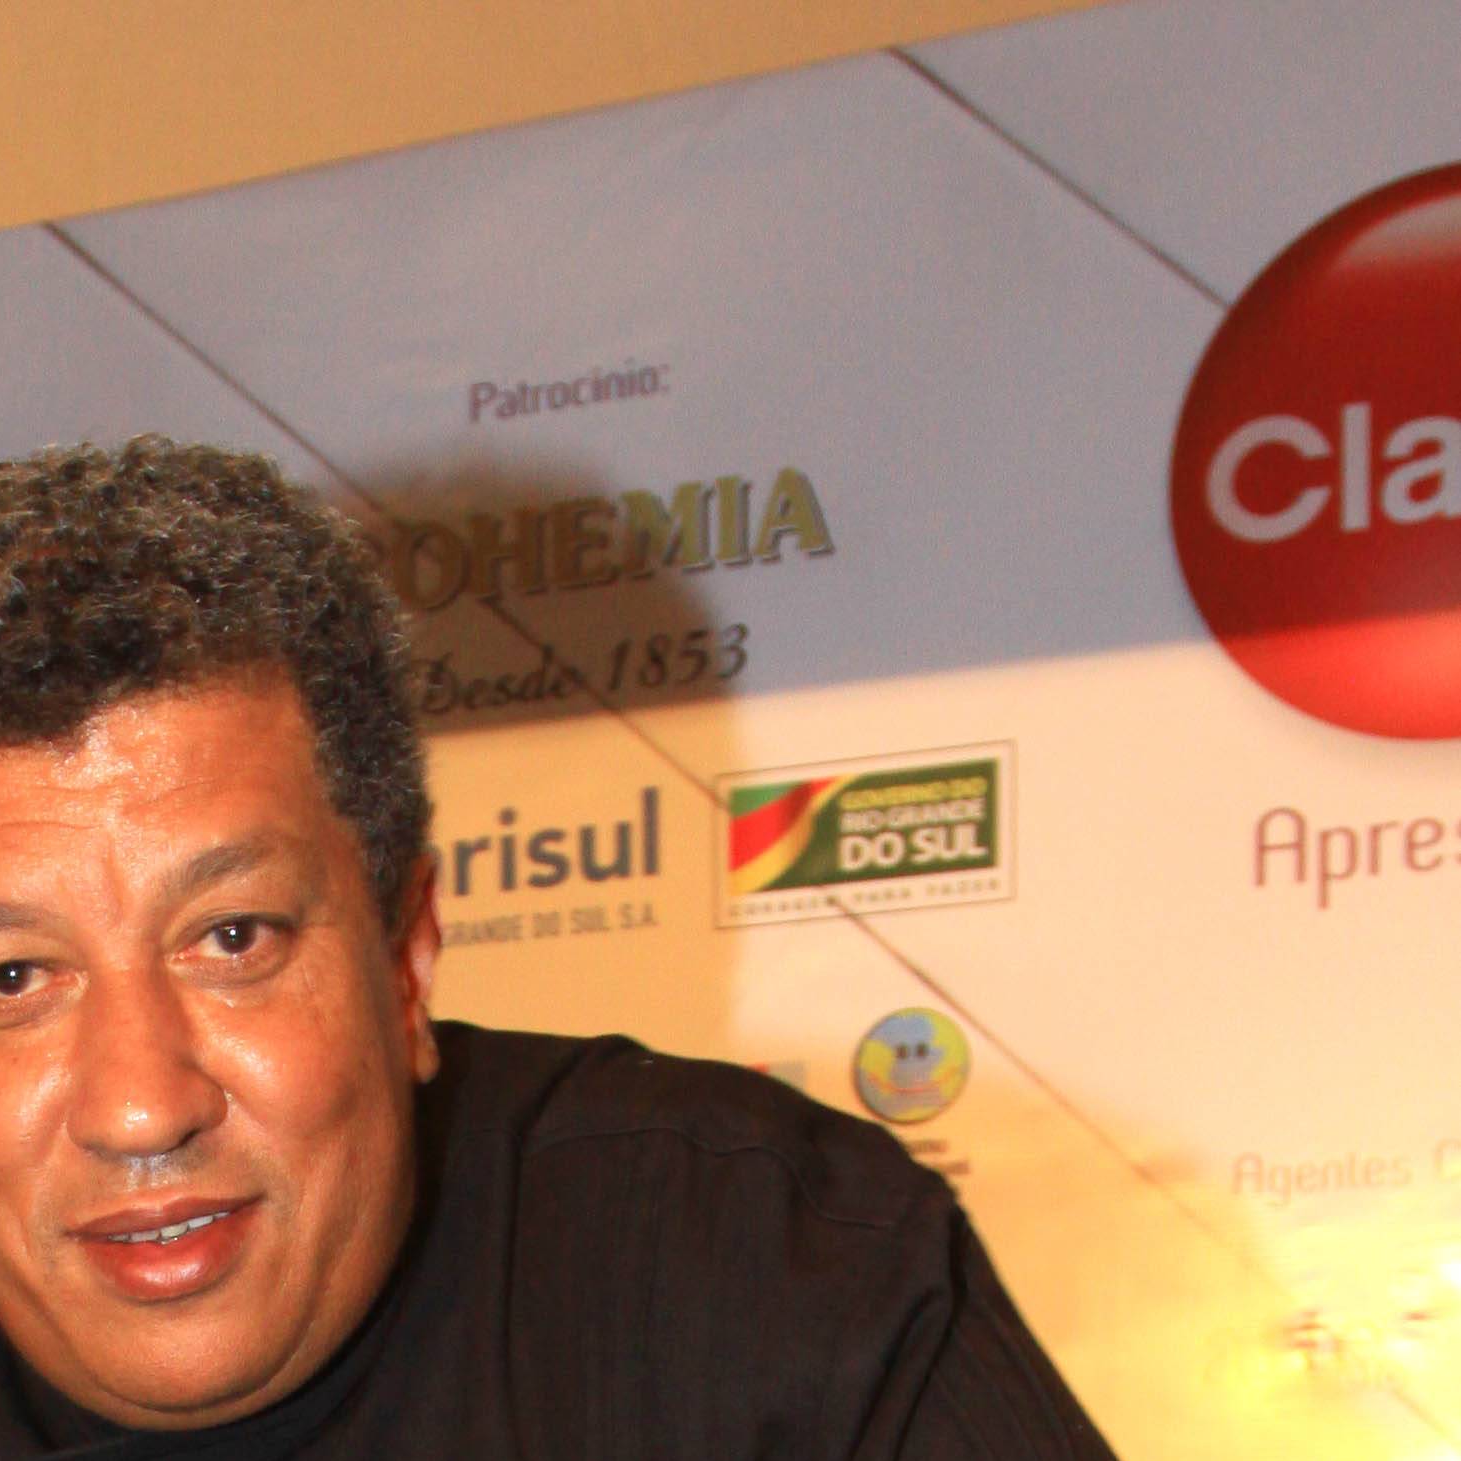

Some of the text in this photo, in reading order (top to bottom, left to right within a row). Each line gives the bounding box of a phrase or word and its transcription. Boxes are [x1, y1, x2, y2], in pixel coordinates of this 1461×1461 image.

[1205, 403, 1461, 542] Cla
[347, 464, 836, 613] OHEMIA
[607, 622, 751, 690] 1853
[434, 786, 660, 897] risul
[841, 822, 988, 871] DO SUL
[1253, 806, 1461, 912] Apre
